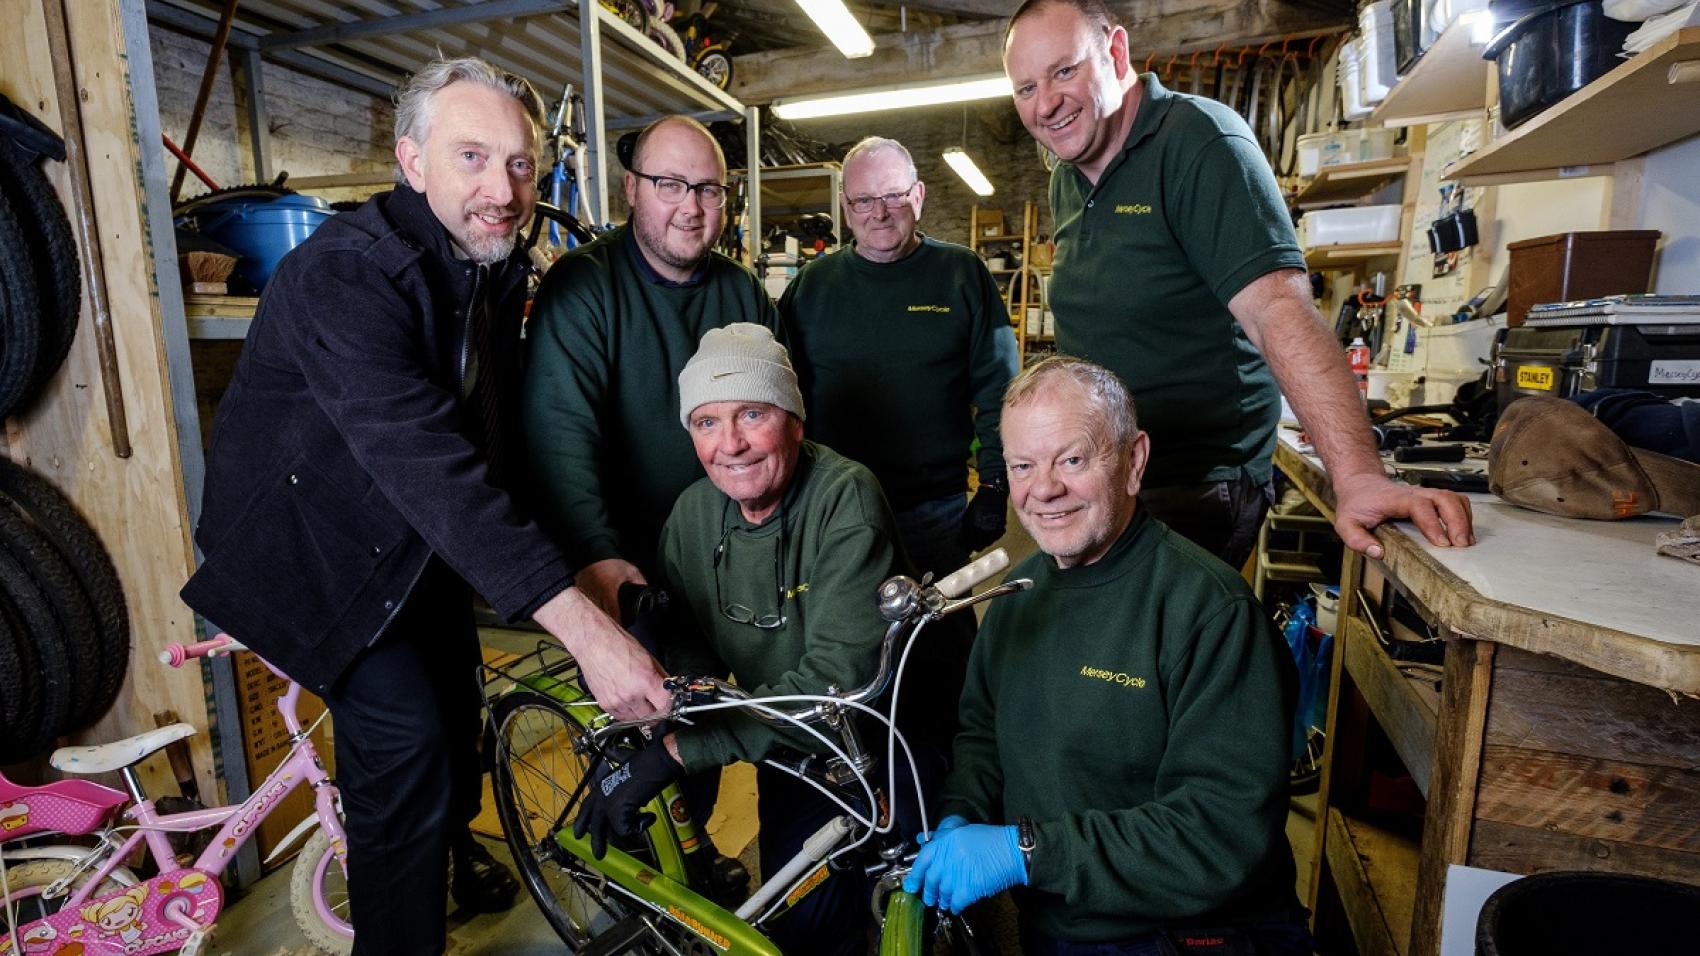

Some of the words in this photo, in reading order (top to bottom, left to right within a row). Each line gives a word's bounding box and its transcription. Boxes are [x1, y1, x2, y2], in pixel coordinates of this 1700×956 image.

[1519, 371, 1550, 385] STANLEY
[1080, 665, 1146, 689] MerseyCycle
[232, 781, 288, 837] CUPCAKE
